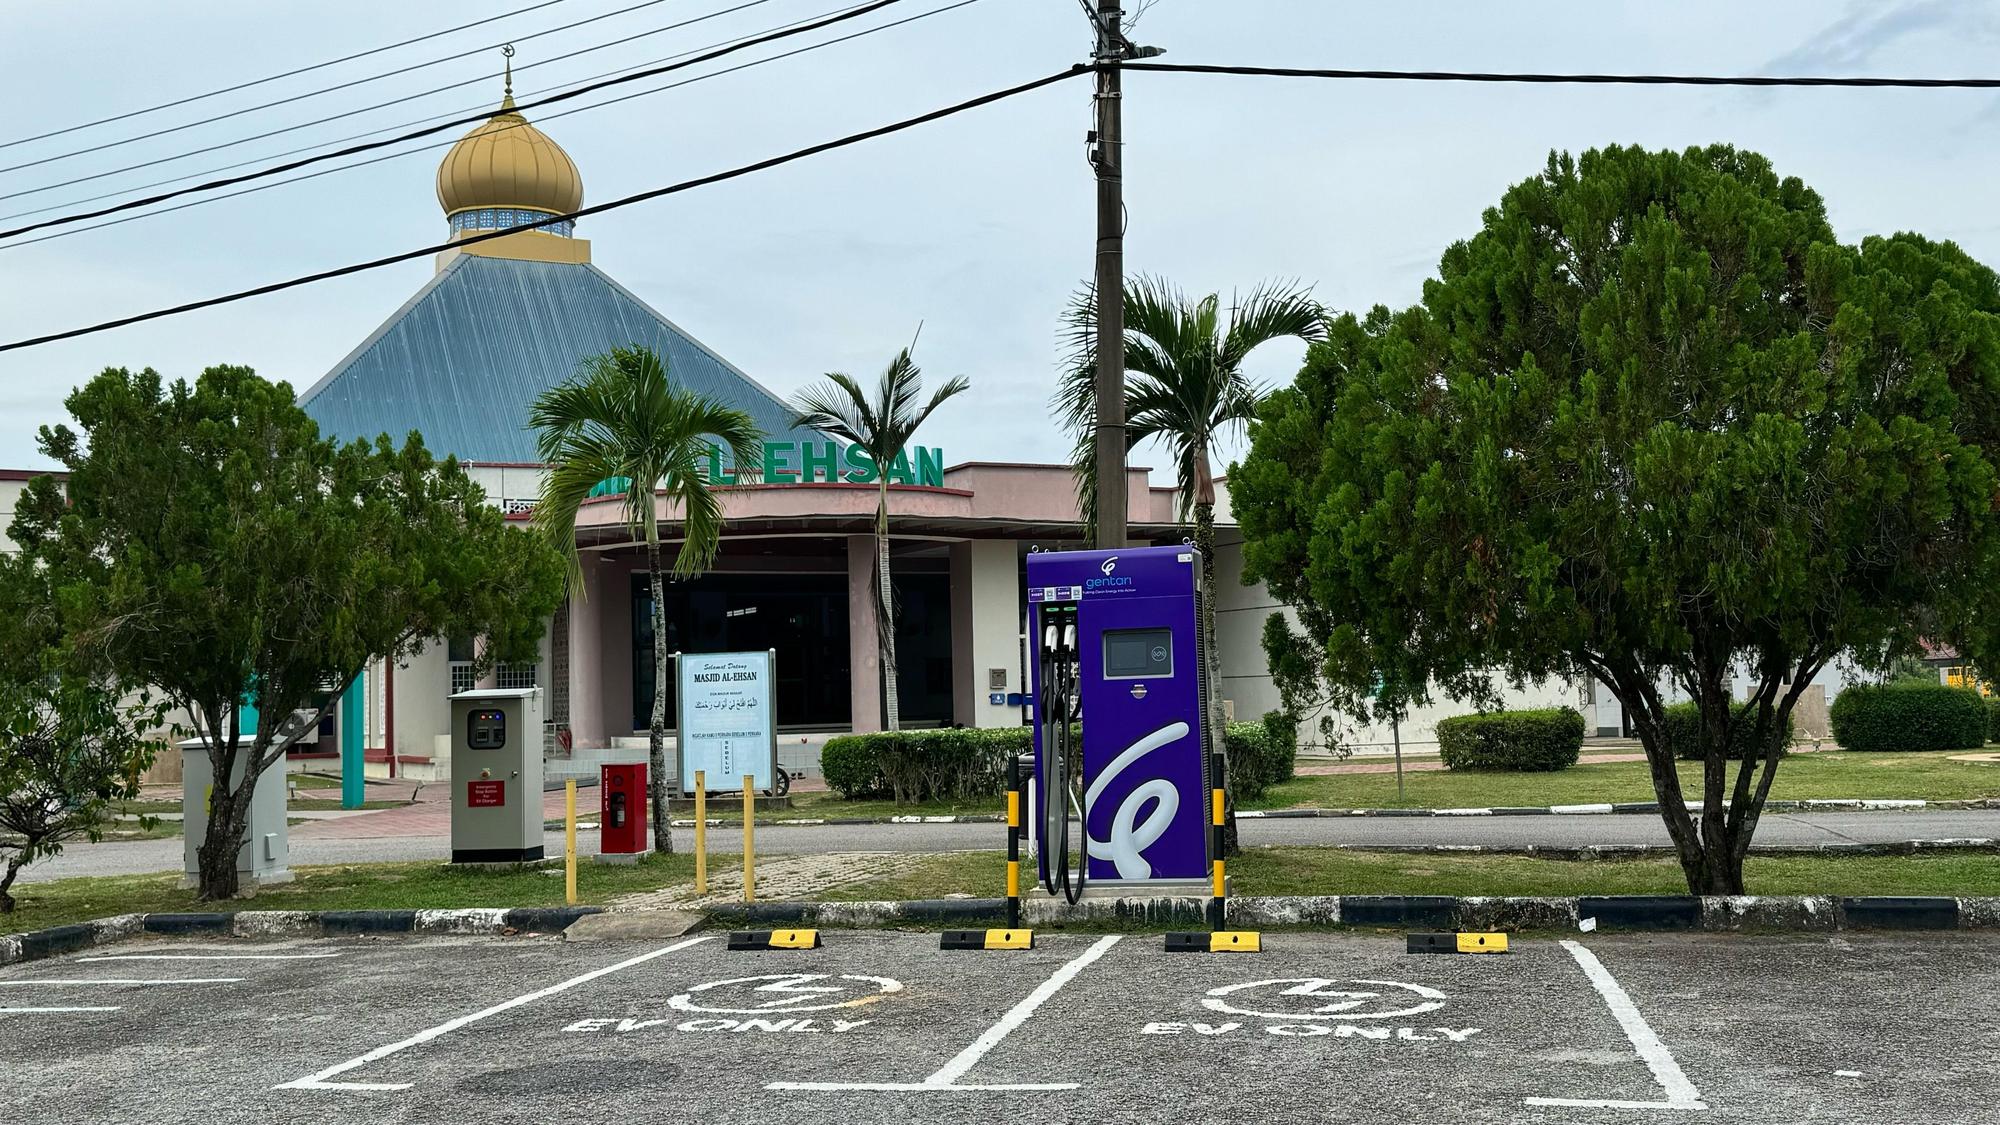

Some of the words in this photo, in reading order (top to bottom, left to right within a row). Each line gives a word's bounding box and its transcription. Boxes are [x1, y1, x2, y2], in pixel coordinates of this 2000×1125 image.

[1086, 576, 1132, 590] gentari
[704, 663, 726, 671] Selamat
[727, 662, 747, 670] Datang
[694, 673, 721, 682] MASJID
[722, 672, 757, 682] AL-EHSAN
[560, 1018, 668, 1033] EV
[676, 1018, 873, 1033] ONLY
[1140, 1021, 1243, 1035] EV
[1265, 1024, 1483, 1042] ONLY
